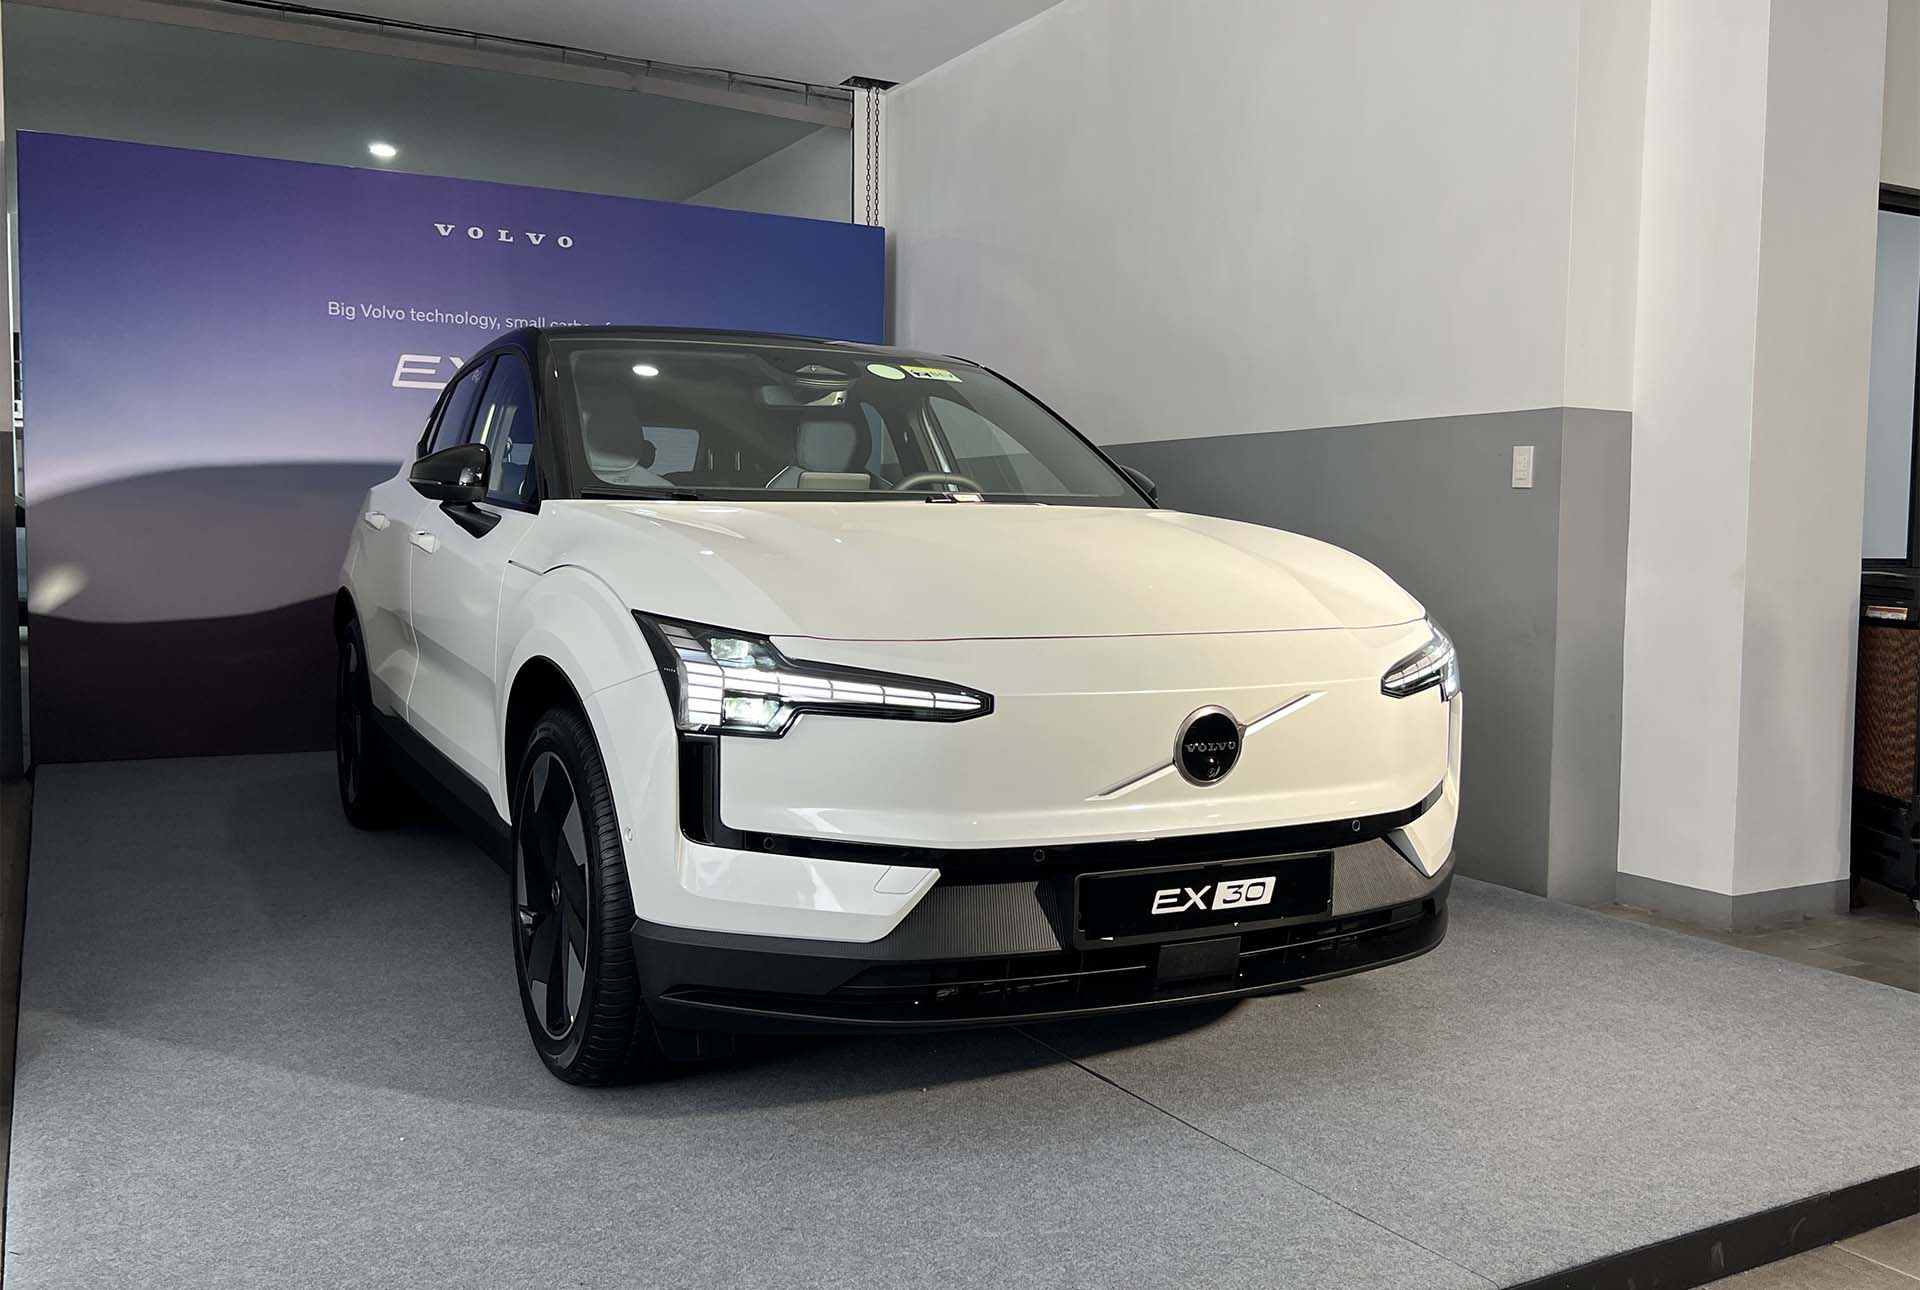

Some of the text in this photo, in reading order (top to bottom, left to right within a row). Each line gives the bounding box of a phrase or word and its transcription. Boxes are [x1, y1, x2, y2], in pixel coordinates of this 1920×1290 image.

[434, 223, 574, 248] VOLVO
[328, 301, 356, 320] Big
[360, 303, 405, 321] Volvo
[410, 308, 501, 330] technology,
[1185, 741, 1237, 753] VOLVO
